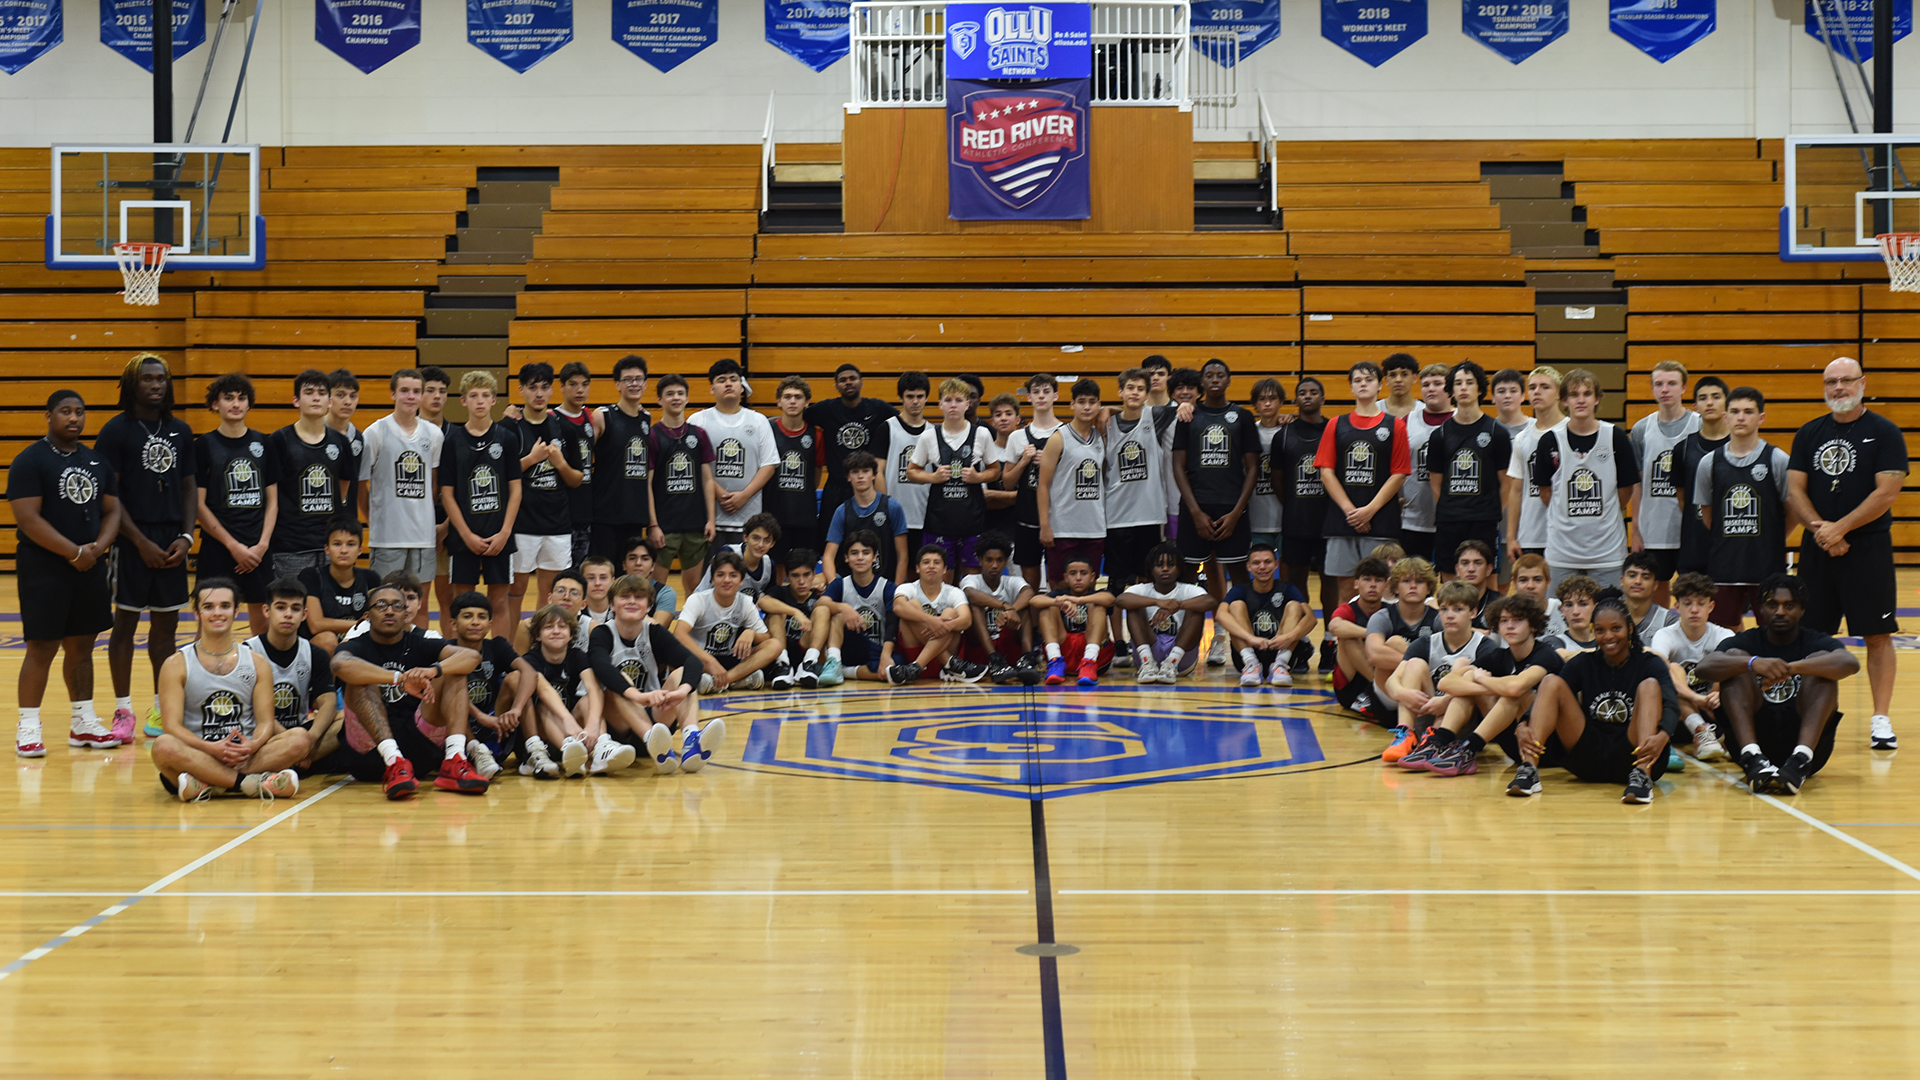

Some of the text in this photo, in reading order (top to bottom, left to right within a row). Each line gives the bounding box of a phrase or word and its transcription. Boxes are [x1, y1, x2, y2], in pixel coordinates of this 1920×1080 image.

[1648, 0, 1678, 8] 2018
[786, 7, 848, 19] 2017-2018
[1212, 9, 1244, 20] 2018
[1358, 8, 1390, 20] 2018
[1478, 5, 1553, 16] 2017 2018
[17, 16, 47, 26] 2017
[116, 14, 147, 26] 2016
[351, 14, 383, 26] 2016
[504, 14, 535, 25] 2017
[650, 13, 680, 24] 2017
[984, 6, 1053, 46] OLLU
[1342, 24, 1408, 32] WOMEN'S MEET
[346, 36, 388, 44] CHAMPIONS
[1351, 35, 1399, 43] CHAMPIONS
[988, 43, 1050, 70] SAINTS
[1002, 68, 1036, 76] NETWORK
[962, 115, 1074, 150] RED RIVER
[964, 137, 1074, 158] ATHLETIC CONFERENCE
[1120, 472, 1148, 482] CAMPS
[1345, 476, 1373, 484] CAMPS
[397, 488, 424, 497] CAMPS
[1652, 488, 1677, 496] CAMP
[302, 504, 332, 512] CAMPS
[472, 504, 499, 512] CAMPS
[1569, 508, 1602, 518] CAMPS
[1724, 520, 1758, 528] BASKETBALL
[1724, 526, 1758, 534] CAMPS
